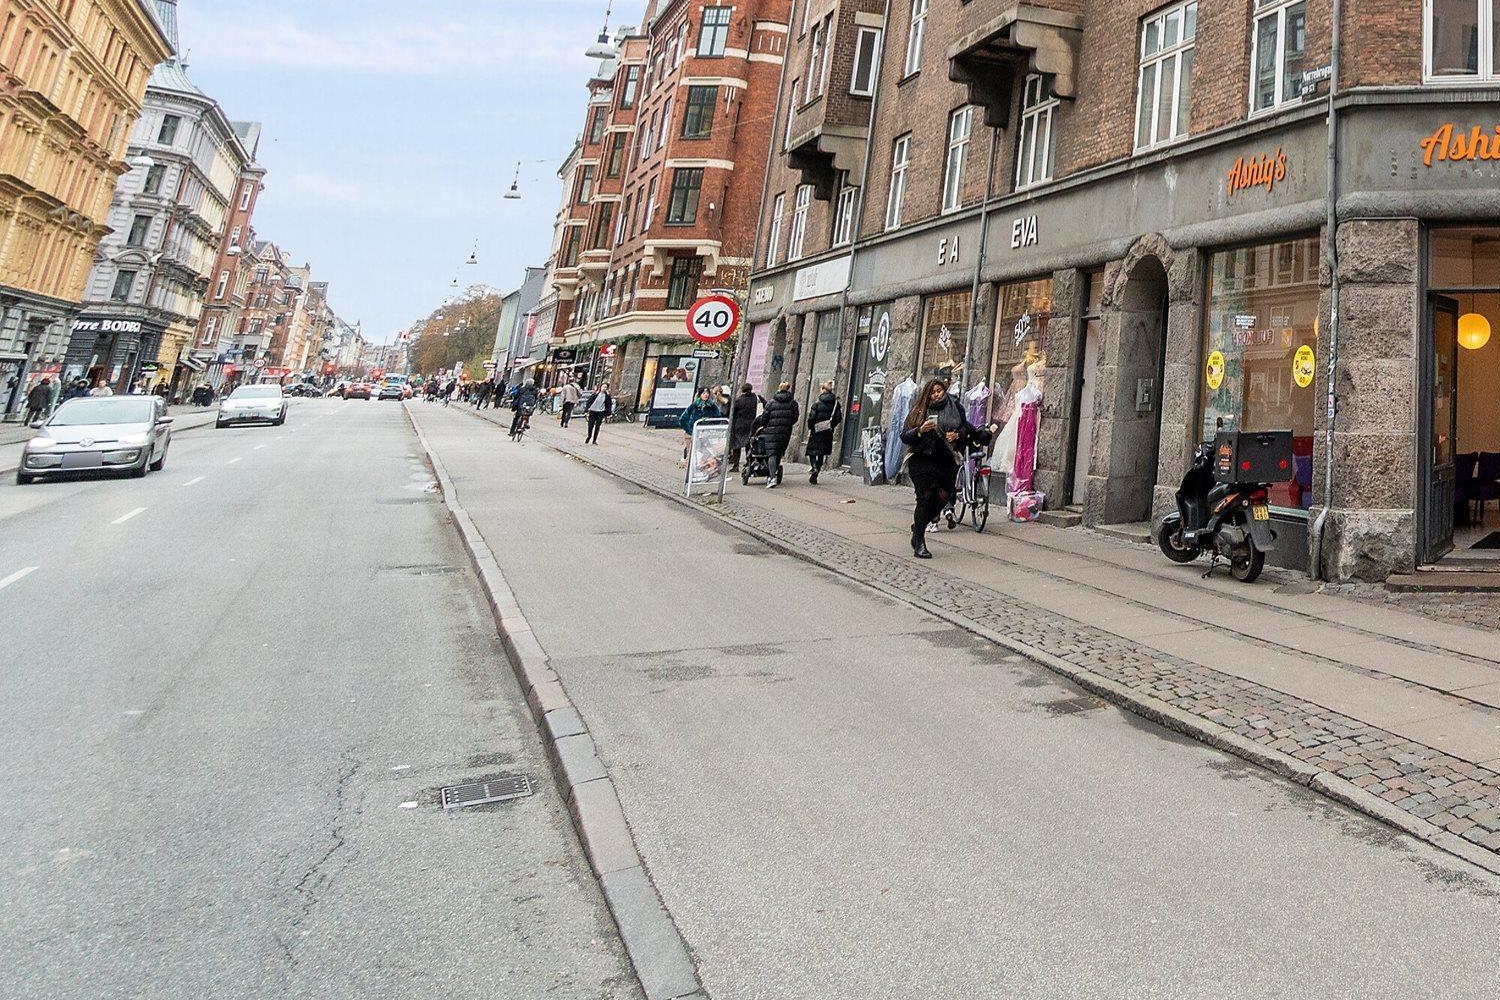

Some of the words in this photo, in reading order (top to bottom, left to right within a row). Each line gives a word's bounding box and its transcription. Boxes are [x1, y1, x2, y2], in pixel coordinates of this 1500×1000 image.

[1227, 146, 1287, 197] Ashiq's
[1011, 215, 1039, 249] EVA
[695, 310, 729, 328] 40
